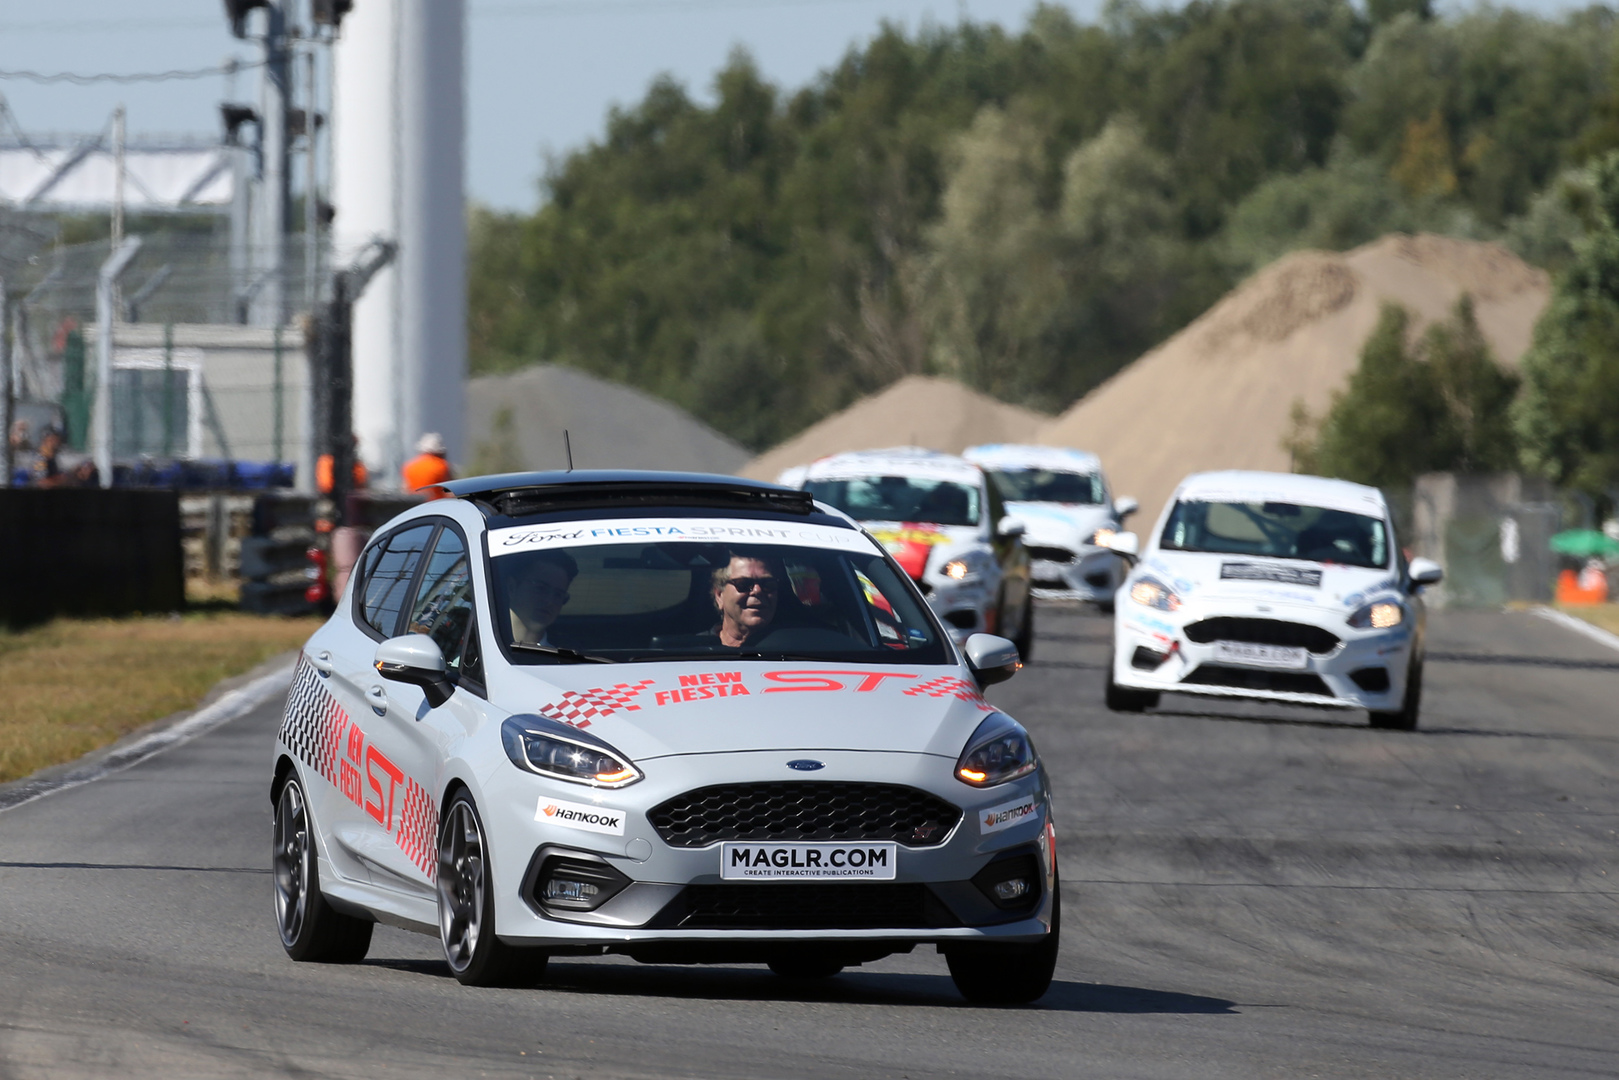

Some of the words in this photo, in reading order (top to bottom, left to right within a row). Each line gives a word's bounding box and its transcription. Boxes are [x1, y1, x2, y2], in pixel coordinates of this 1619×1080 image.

[502, 528, 584, 546] Ford
[591, 527, 686, 538] FIESTA
[690, 526, 791, 538] SPRINT
[798, 531, 850, 544] CUP
[678, 671, 742, 687] NEW
[760, 670, 922, 694] ST
[655, 683, 750, 706] FIESTA
[347, 722, 365, 768] NEW
[340, 758, 363, 809] FIESTA
[365, 741, 405, 834] ST
[731, 848, 887, 867] MAGLR.COM
